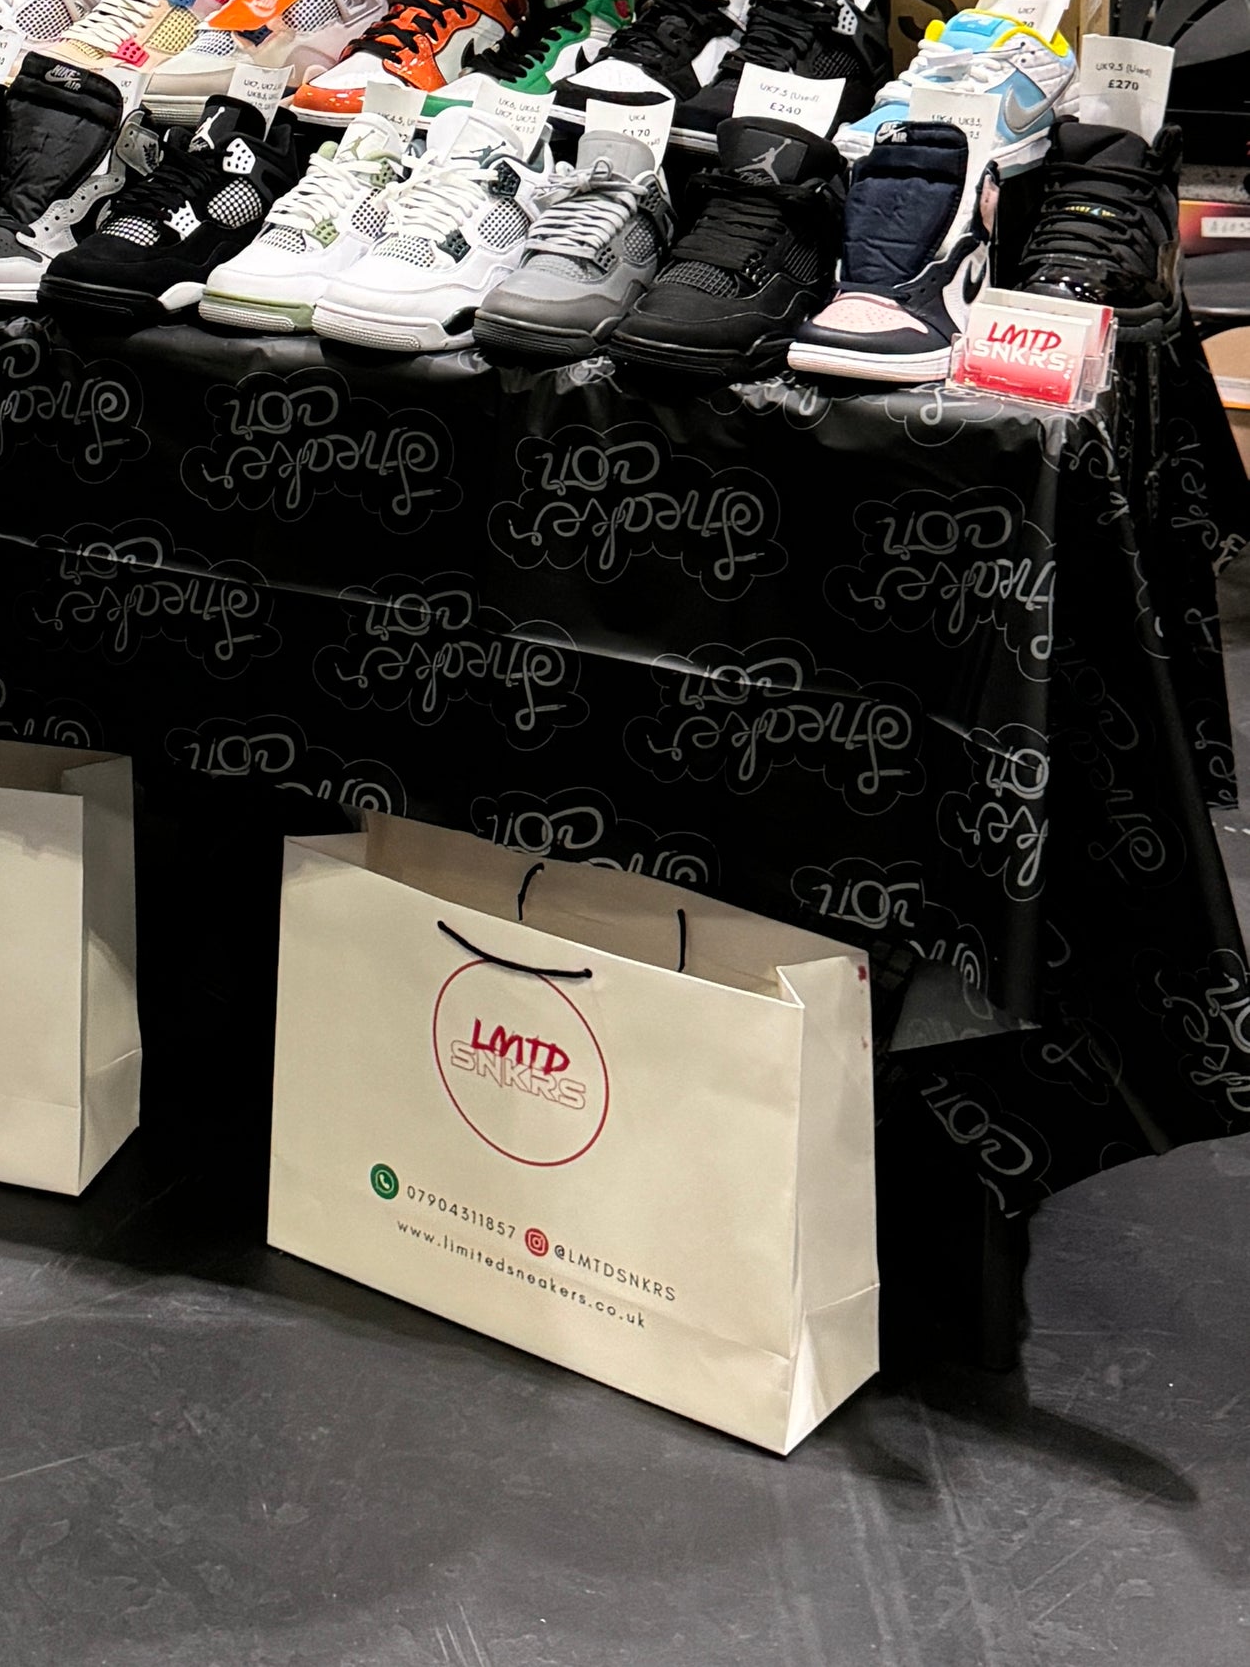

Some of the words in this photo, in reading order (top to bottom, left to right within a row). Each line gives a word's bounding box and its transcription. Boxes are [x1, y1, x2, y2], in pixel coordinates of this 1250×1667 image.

[52, 64, 81, 78] NIKE
[63, 80, 82, 92] AIR
[1107, 79, 1139, 91] £270
[769, 102, 802, 116] £240
[986, 321, 1063, 353] LMTD
[971, 338, 1069, 372] SNKRS
[470, 1017, 571, 1076] LMTD
[449, 1039, 587, 1111] SNKRS
[395, 1220, 648, 1330] www.limitedsneakers.co.uk
[553, 1243, 677, 1303] @LMTDSNKRS
